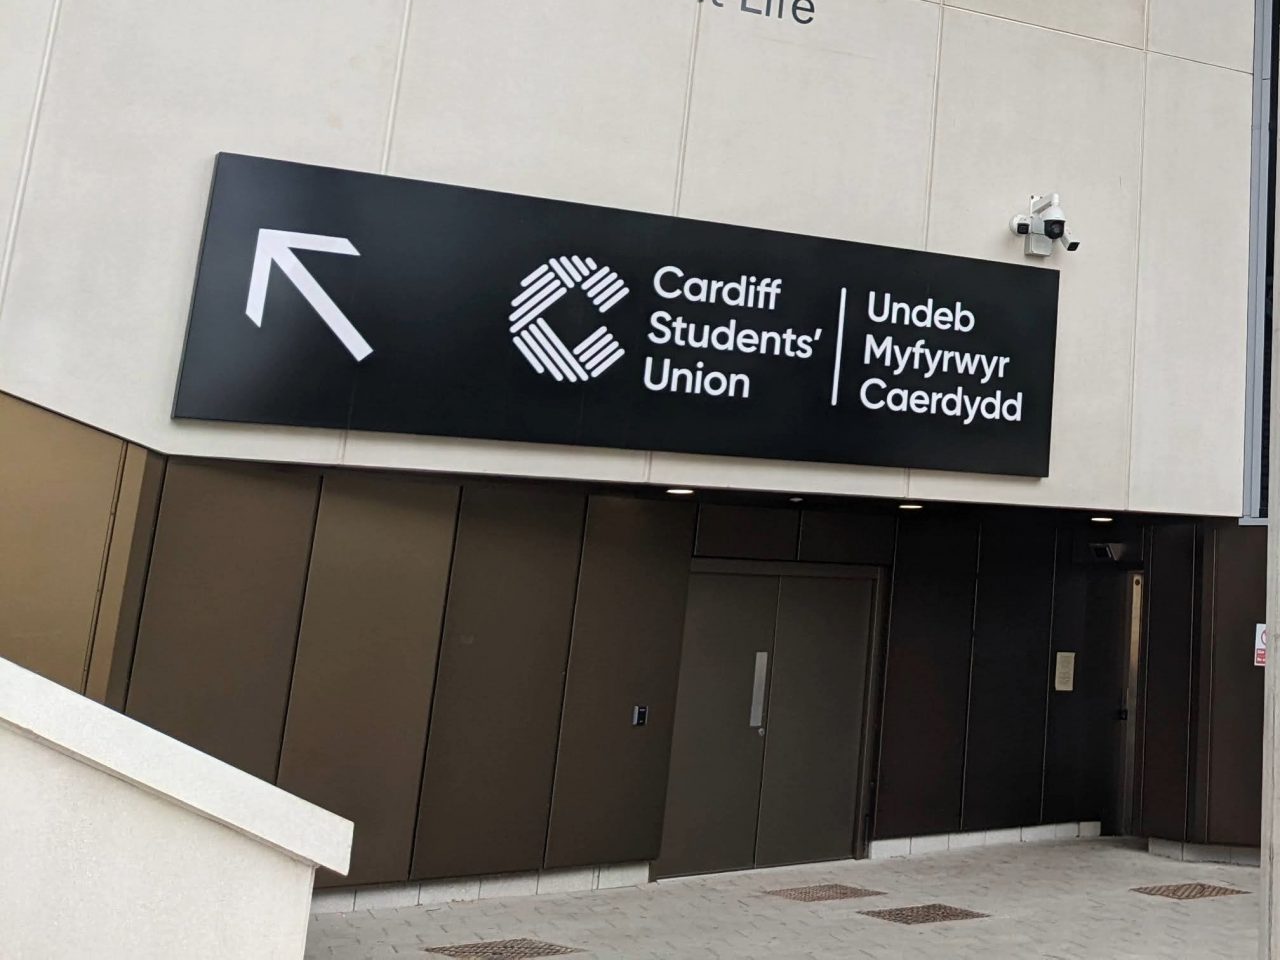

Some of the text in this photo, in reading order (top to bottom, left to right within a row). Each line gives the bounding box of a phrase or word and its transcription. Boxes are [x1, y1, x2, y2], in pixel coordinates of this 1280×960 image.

[652, 265, 783, 310] Cardiff
[867, 291, 976, 332] Undeb
[643, 356, 750, 398] Union
[863, 333, 1010, 384] Myfyrwyr
[859, 378, 1023, 425] Caerdydd
